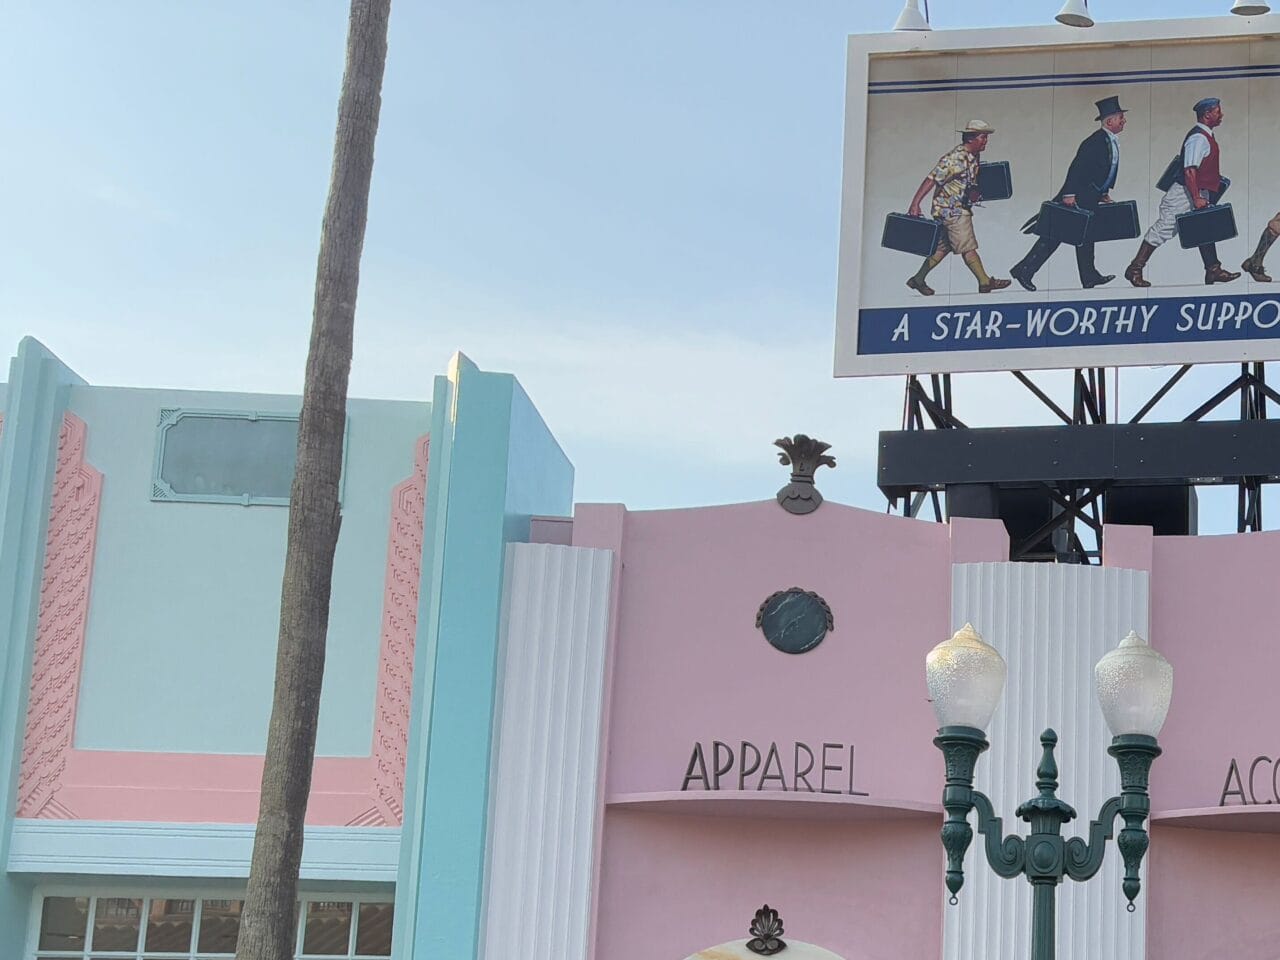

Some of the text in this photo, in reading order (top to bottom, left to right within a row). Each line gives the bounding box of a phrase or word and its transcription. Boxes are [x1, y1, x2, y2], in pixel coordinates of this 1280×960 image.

[891, 312, 910, 342] A
[931, 304, 1160, 340] STAR-WORTHY
[680, 740, 870, 797] APPAREL
